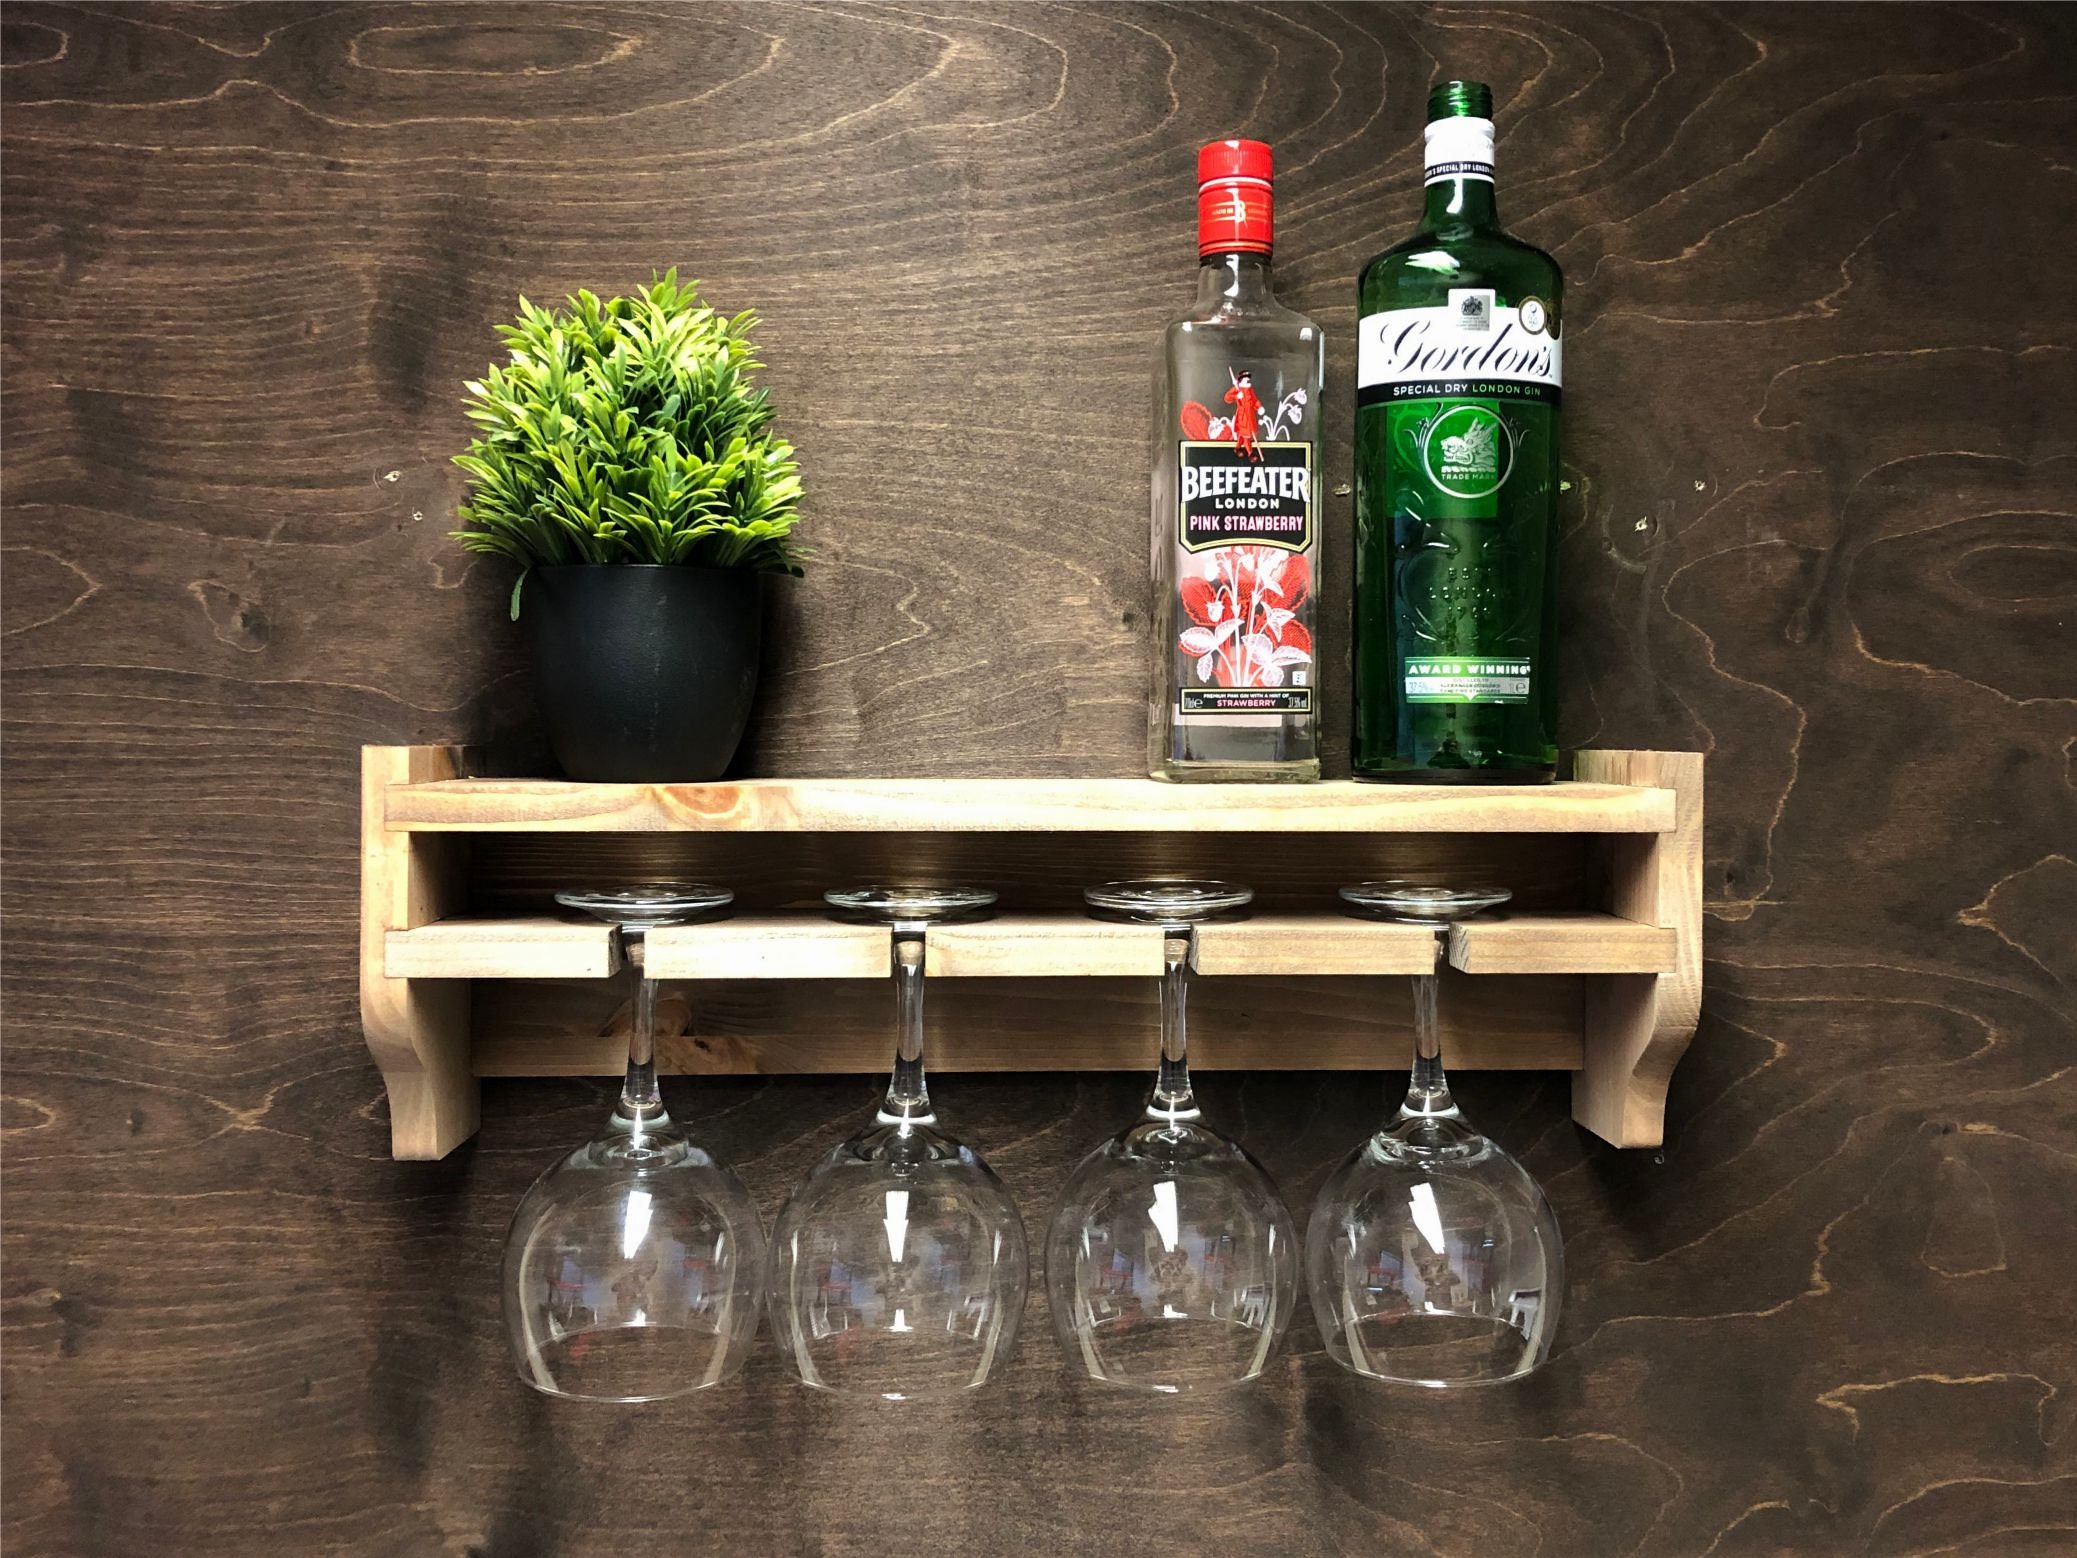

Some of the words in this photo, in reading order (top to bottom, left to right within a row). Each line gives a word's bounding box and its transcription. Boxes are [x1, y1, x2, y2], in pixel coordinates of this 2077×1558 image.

[1380, 320, 1552, 377] Gordon's
[1393, 385, 1441, 396] SPECIAL
[1444, 384, 1469, 394] DRY
[1472, 384, 1521, 395] LONDON
[1524, 386, 1541, 396] GIN
[1181, 466, 1311, 503] BEEFEATER
[1215, 498, 1280, 509] LONDON
[1190, 515, 1220, 531] PINK
[1224, 515, 1304, 531] STRAWBERRY
[1408, 665, 1462, 674] AWARD
[1217, 699, 1276, 707] STRAWBERRY
